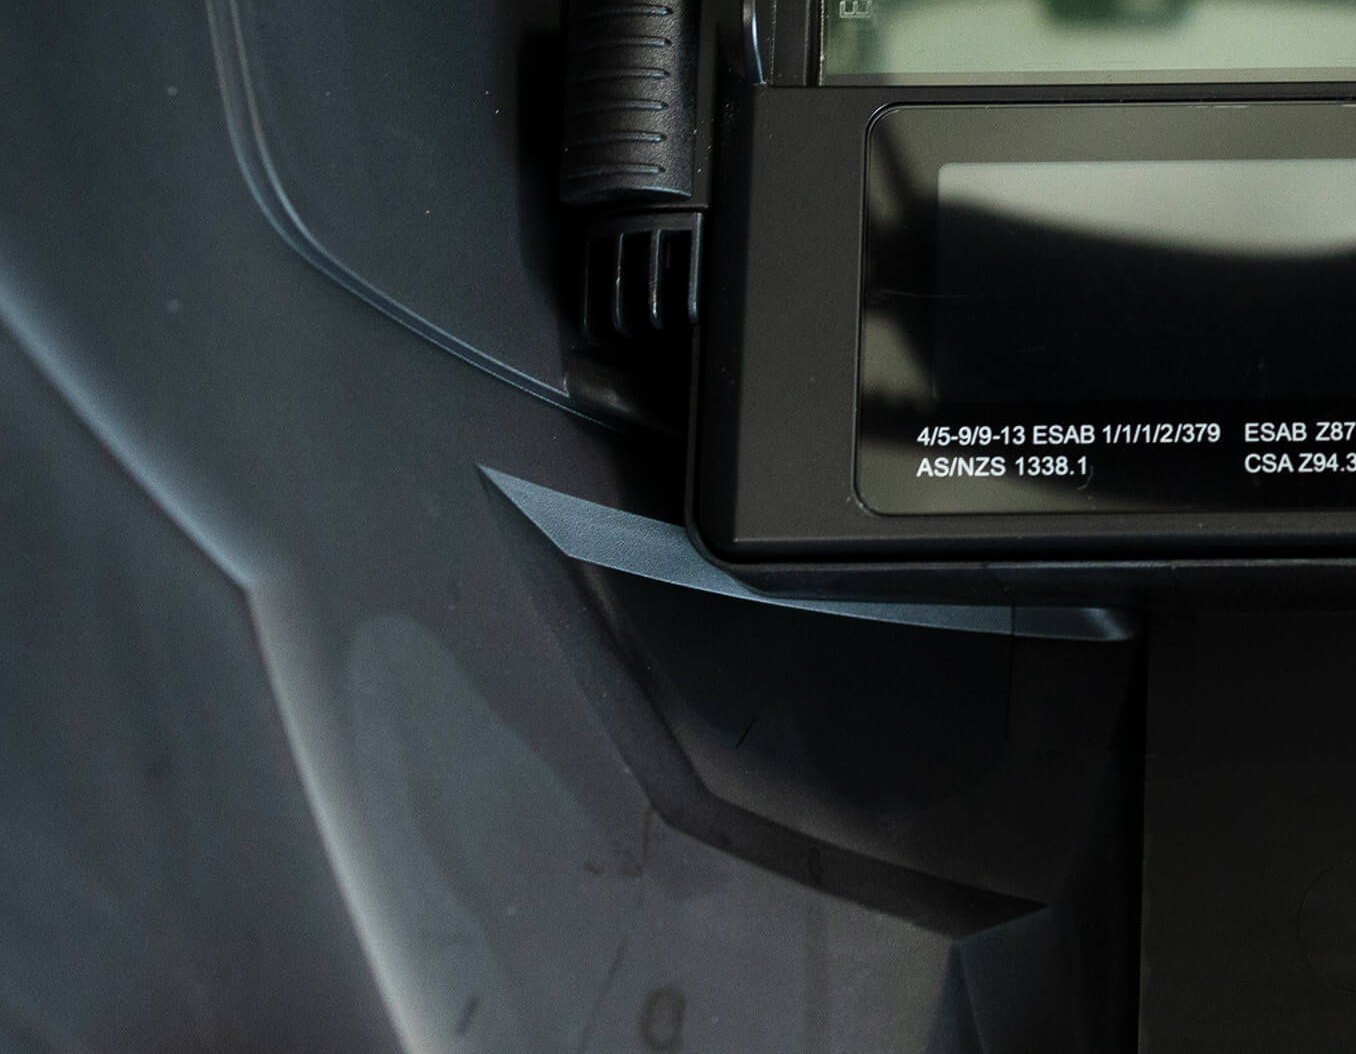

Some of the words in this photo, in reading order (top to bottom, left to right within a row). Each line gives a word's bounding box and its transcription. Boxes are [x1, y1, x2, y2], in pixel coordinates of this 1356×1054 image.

[916, 426, 1025, 446] 4/5-9/9-13
[1033, 425, 1095, 444] ESAB
[1103, 424, 1221, 444] 1/1/1/2/379
[1244, 423, 1306, 443] ESAB
[916, 456, 1006, 477] AS/NZS
[1015, 455, 1088, 476] 1338.1
[1244, 454, 1294, 473] CSA
